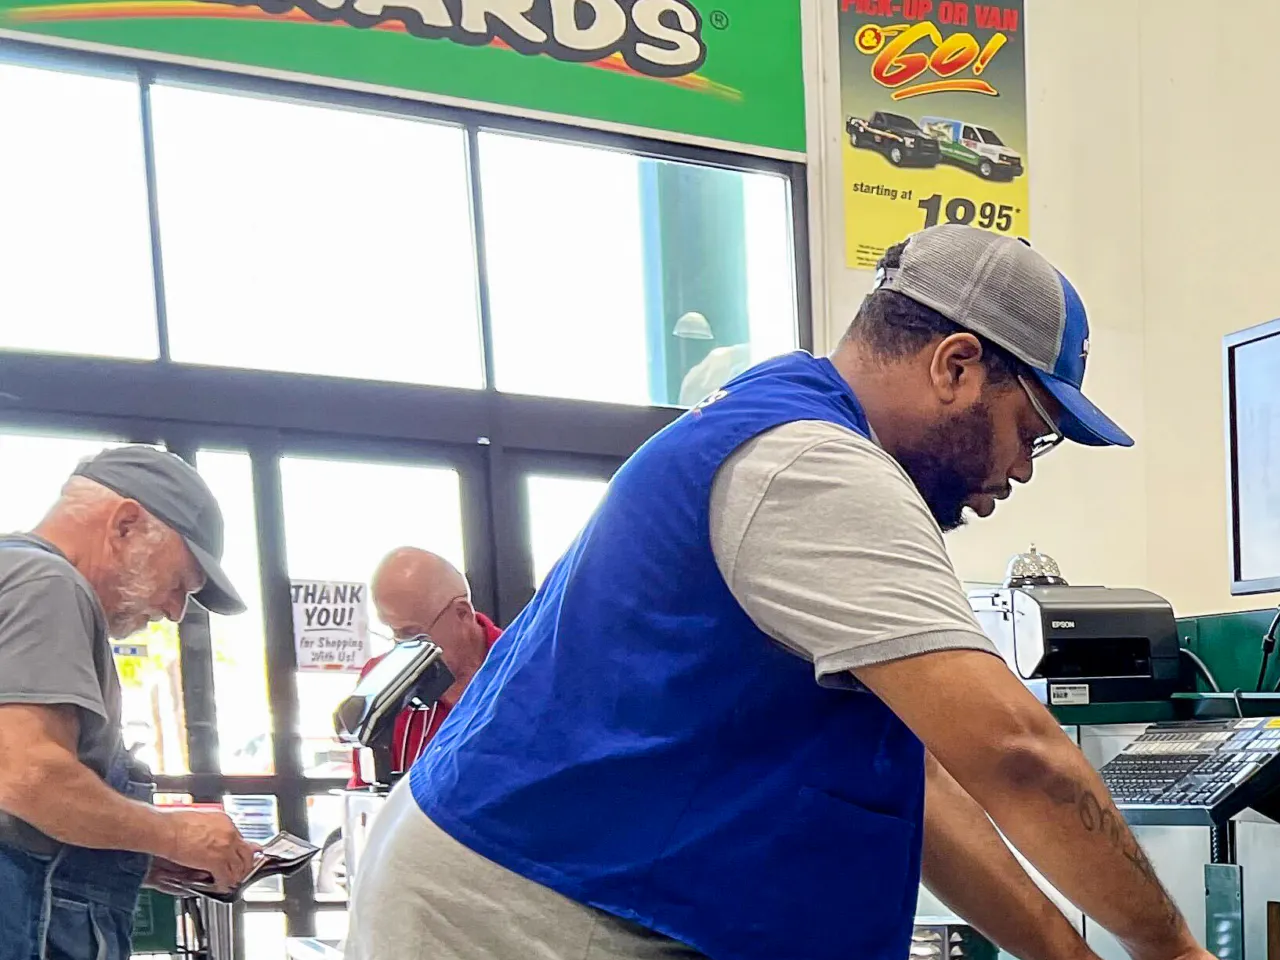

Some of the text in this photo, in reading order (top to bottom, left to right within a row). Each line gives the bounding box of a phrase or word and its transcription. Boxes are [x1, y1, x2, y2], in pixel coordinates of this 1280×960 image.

[938, 1, 968, 26] OR
[975, 5, 1018, 31] VAN
[853, 181, 912, 201] starting at
[291, 584, 363, 604] THANK
[305, 606, 354, 626] YOU!
[300, 636, 363, 651] for Shopping
